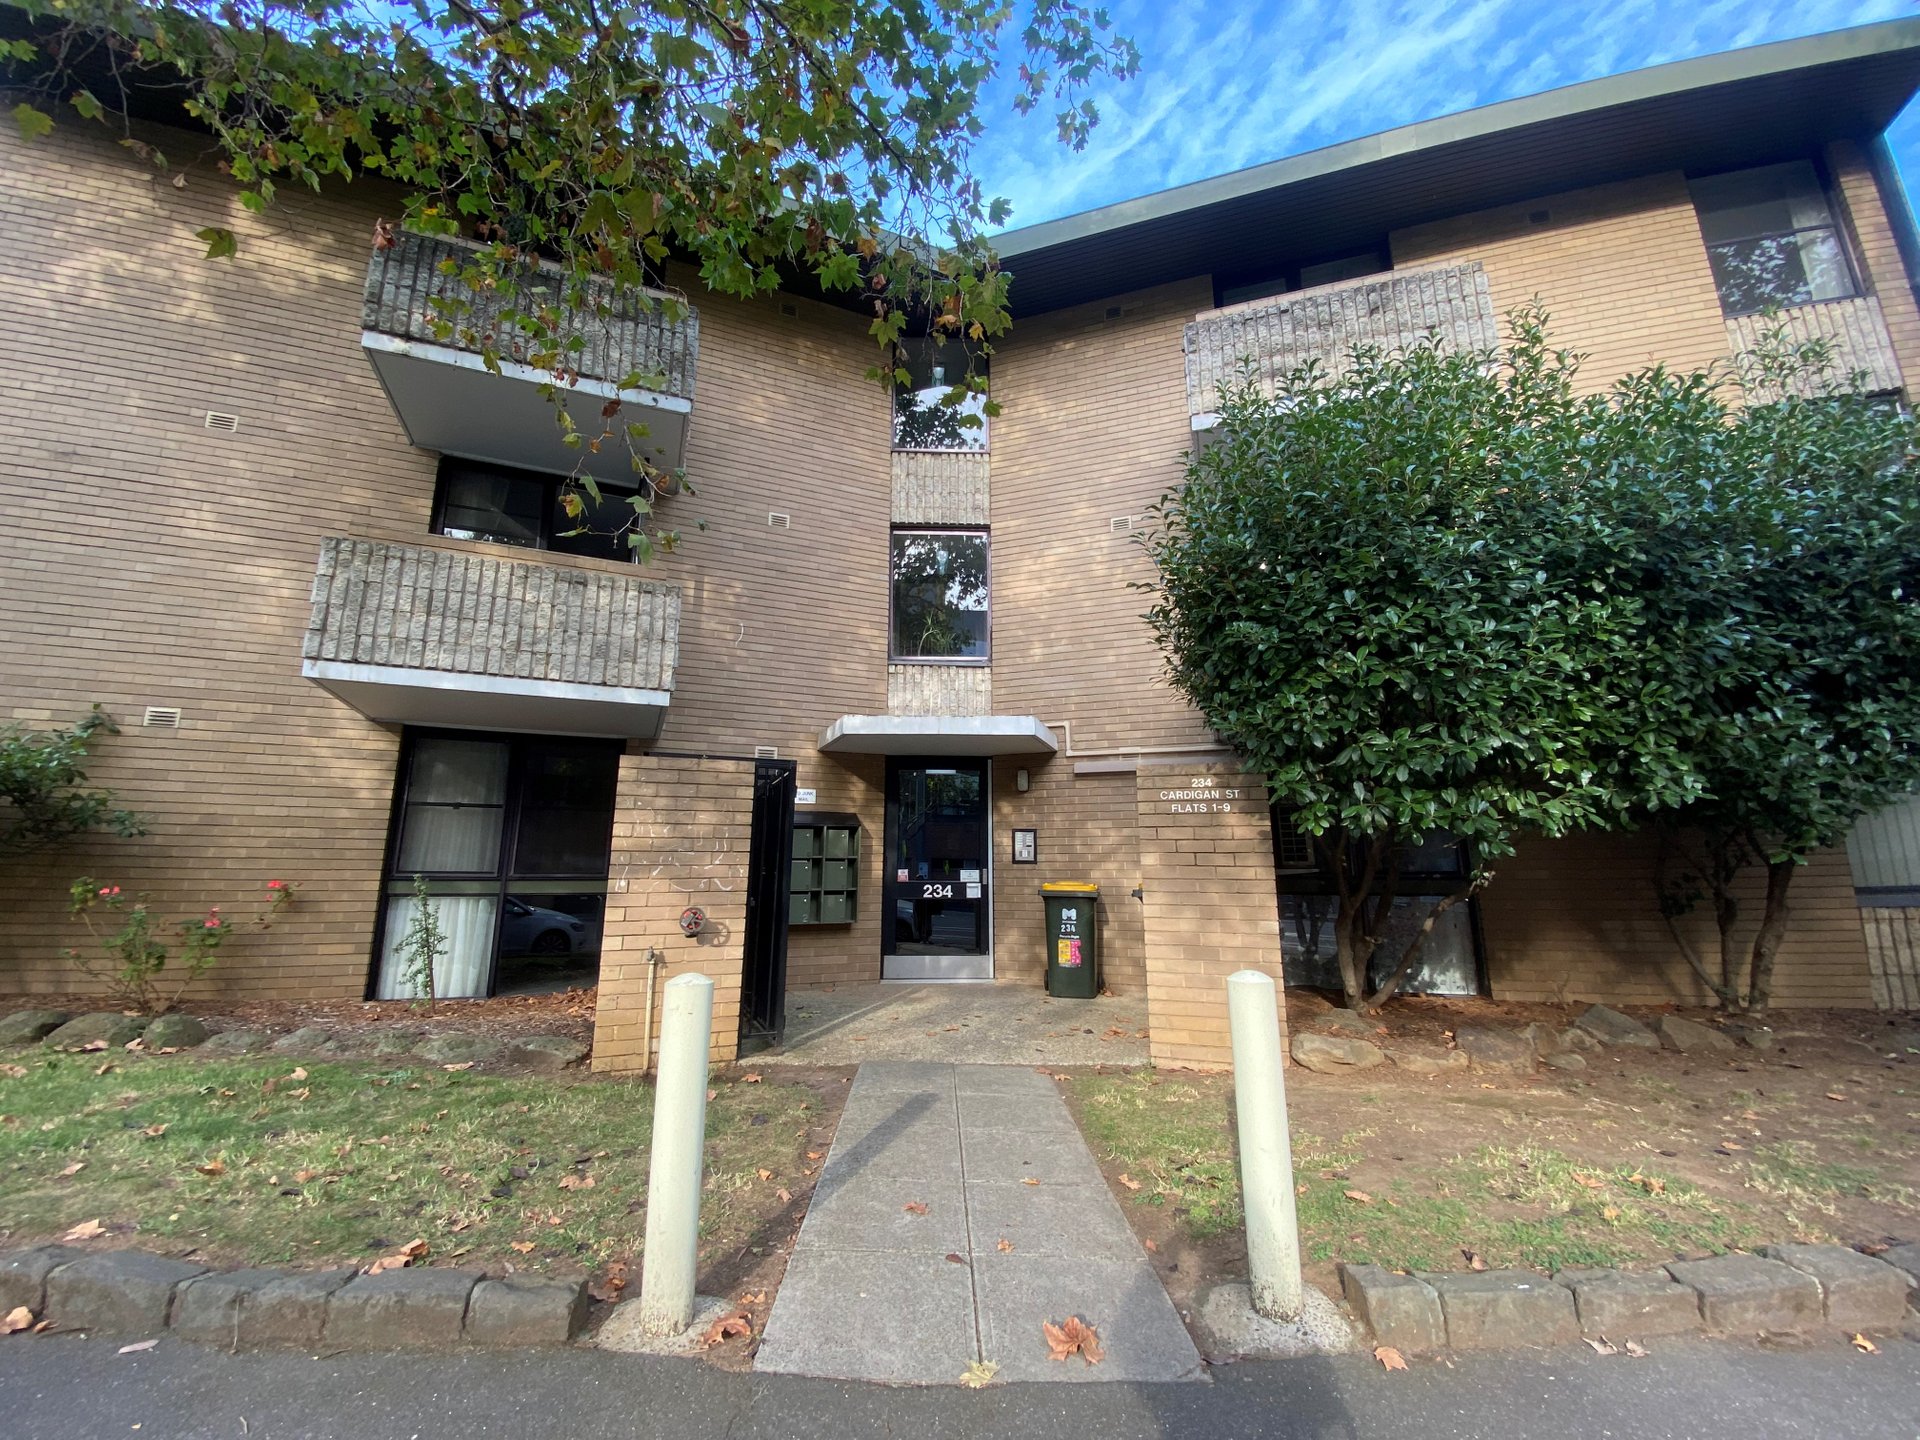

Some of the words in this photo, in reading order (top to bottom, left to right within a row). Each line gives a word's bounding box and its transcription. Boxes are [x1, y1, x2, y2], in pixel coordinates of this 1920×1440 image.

[1191, 778, 1213, 788] 234
[1160, 790, 1219, 800] CARDIGAN
[1225, 789, 1240, 799] ST
[1171, 803, 1207, 813] FLATS
[1212, 803, 1231, 812] 1-9
[923, 884, 953, 898] 234
[1061, 908, 1077, 920] M
